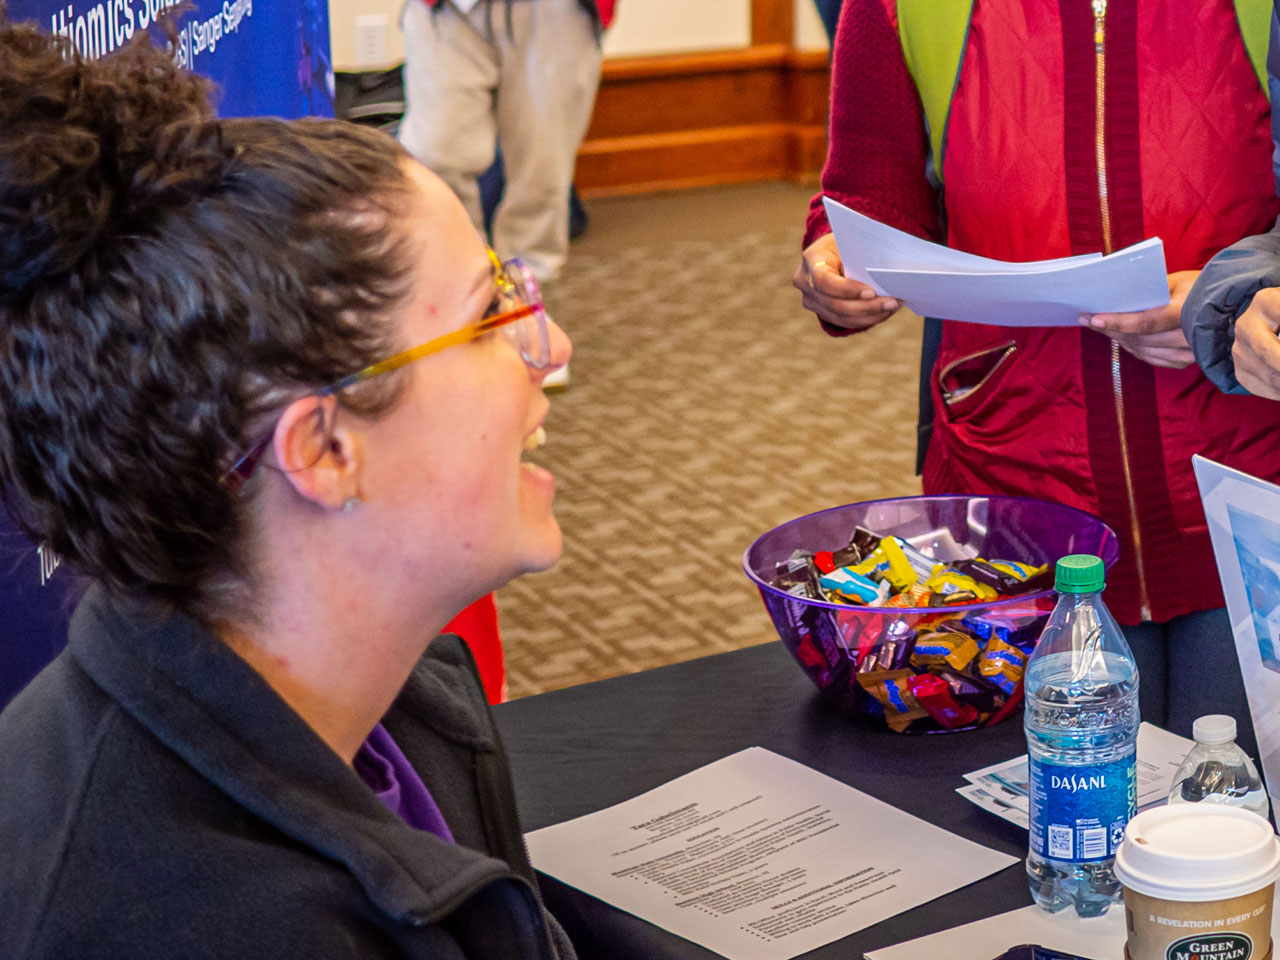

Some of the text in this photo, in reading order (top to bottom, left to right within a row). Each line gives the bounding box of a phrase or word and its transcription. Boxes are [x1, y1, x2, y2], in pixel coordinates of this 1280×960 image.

[192, 12, 223, 55] Sanger
[1051, 774, 1107, 793] DASANI
[1149, 914, 1155, 922] A
[1157, 916, 1212, 928] REVELATION
[1214, 919, 1224, 927] IN
[1226, 912, 1251, 925] EVERY
[1176, 947, 1245, 960] MOUNTAIN
[1189, 940, 1234, 953] GREEN
